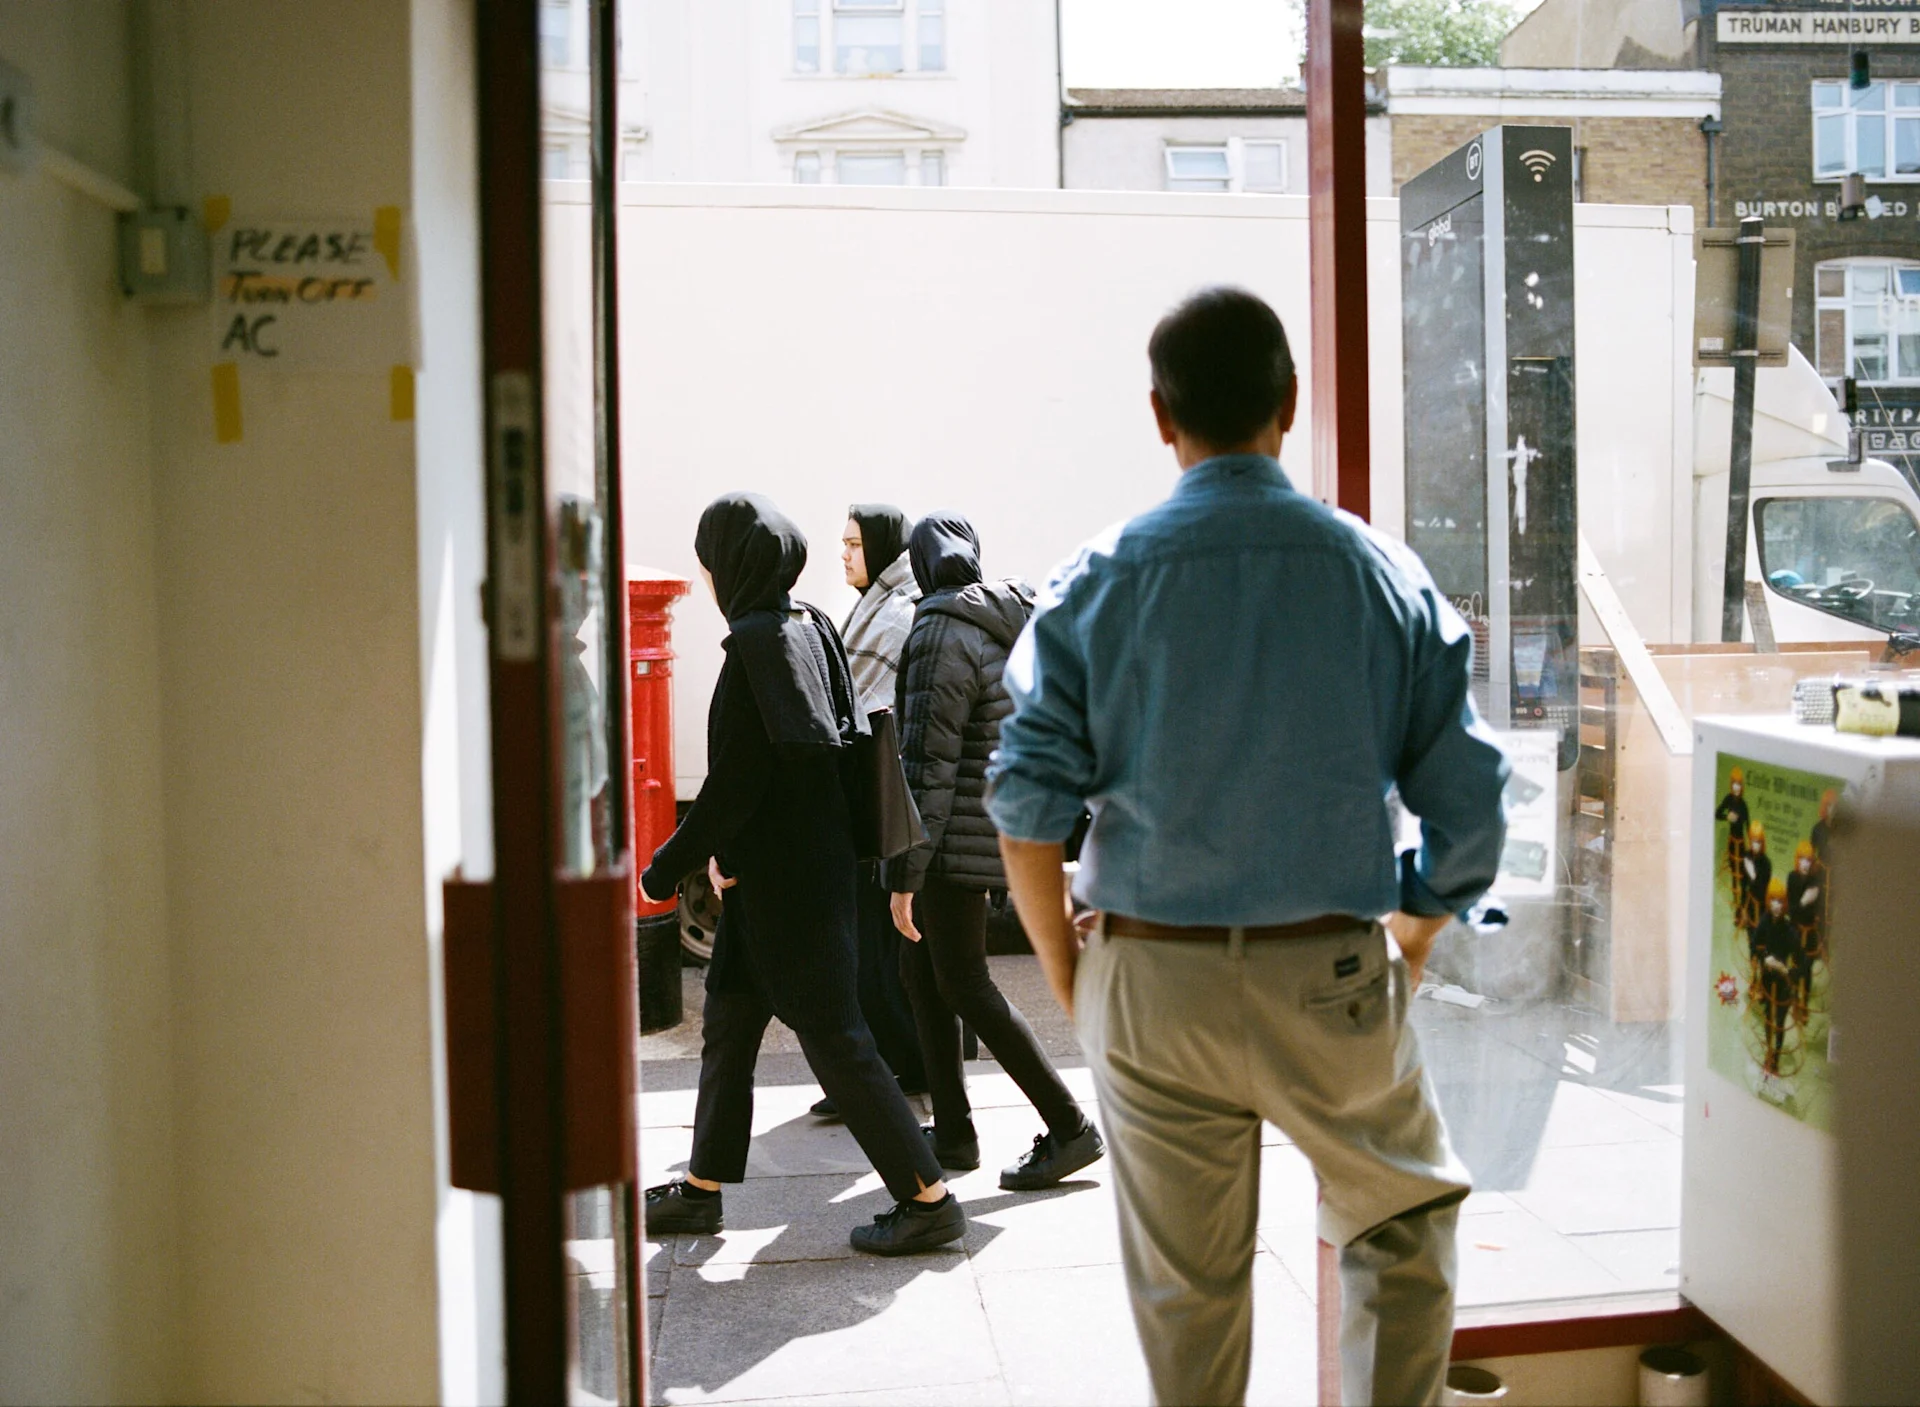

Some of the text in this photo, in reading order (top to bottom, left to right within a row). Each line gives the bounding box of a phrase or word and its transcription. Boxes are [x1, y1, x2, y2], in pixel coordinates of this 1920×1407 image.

[1727, 17, 1802, 33] TRUMAN
[1812, 17, 1901, 34] HANBURY
[1734, 201, 1907, 217] BURTON BED
[229, 228, 373, 264] PLEASE
[221, 313, 279, 357] AC
